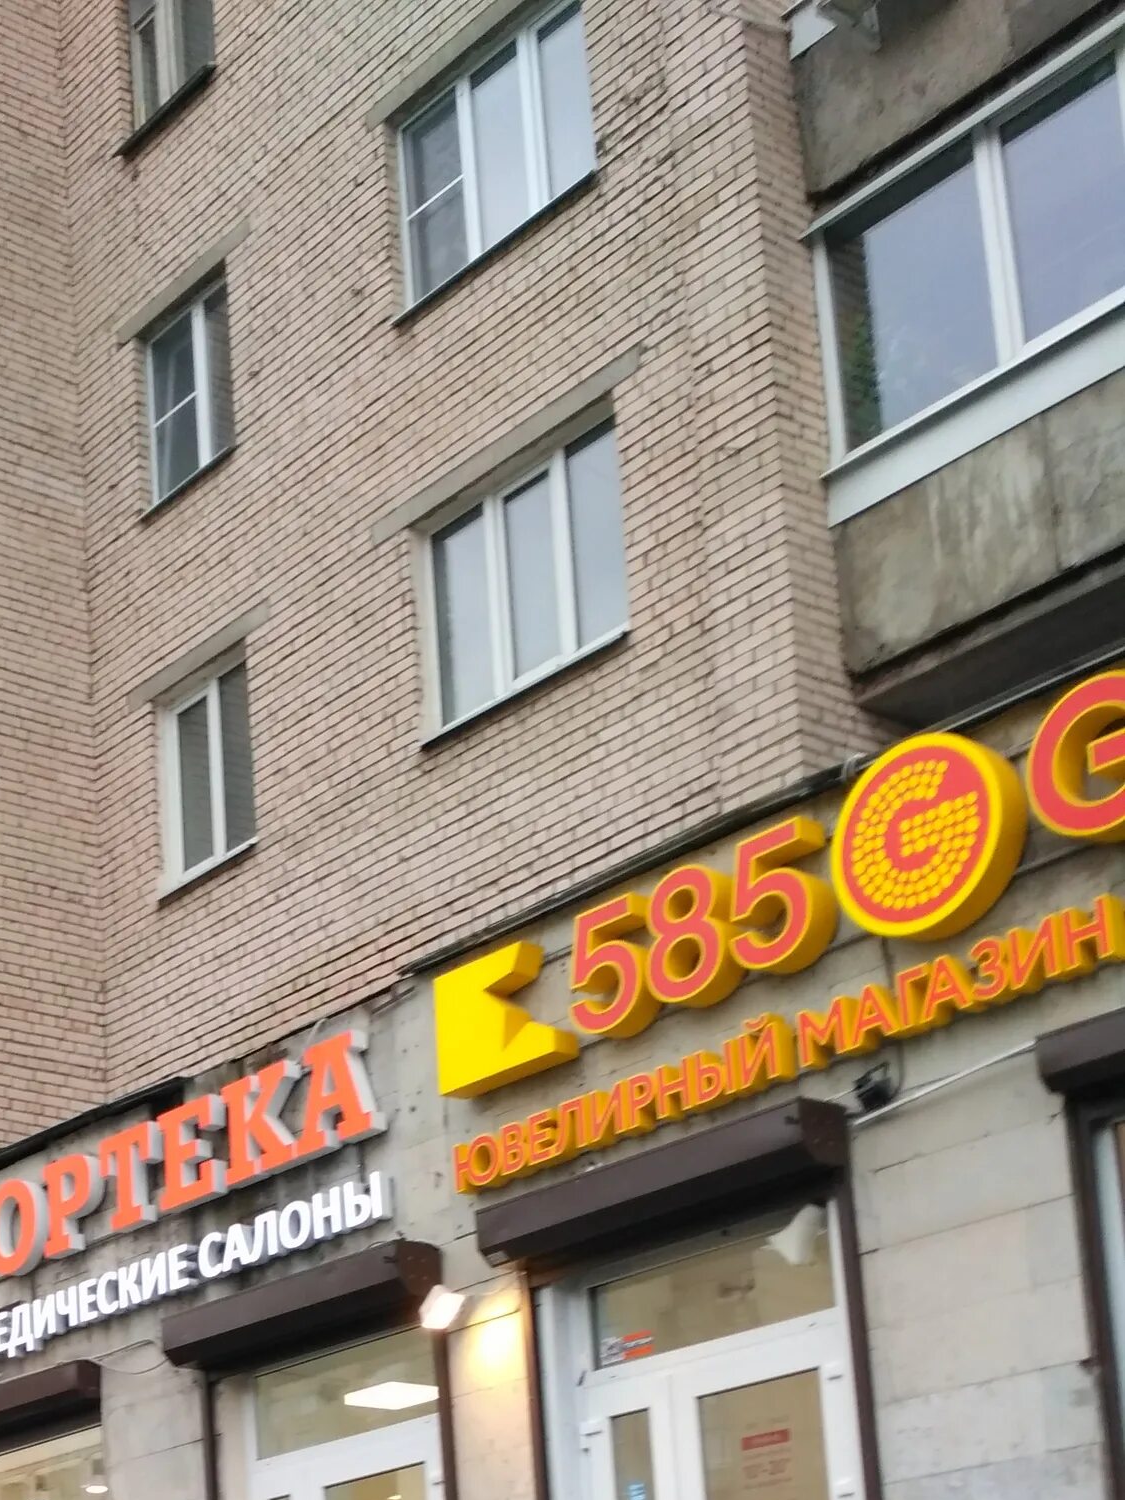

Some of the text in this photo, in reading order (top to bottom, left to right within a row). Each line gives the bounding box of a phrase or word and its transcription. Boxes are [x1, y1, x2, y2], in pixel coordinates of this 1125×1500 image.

[569, 816, 831, 1037] 585
[453, 895, 1121, 1193] ЮВЕЛИРНЫЙ МАГАЗИН
[197, 1171, 386, 1280] САЛОНЫ
